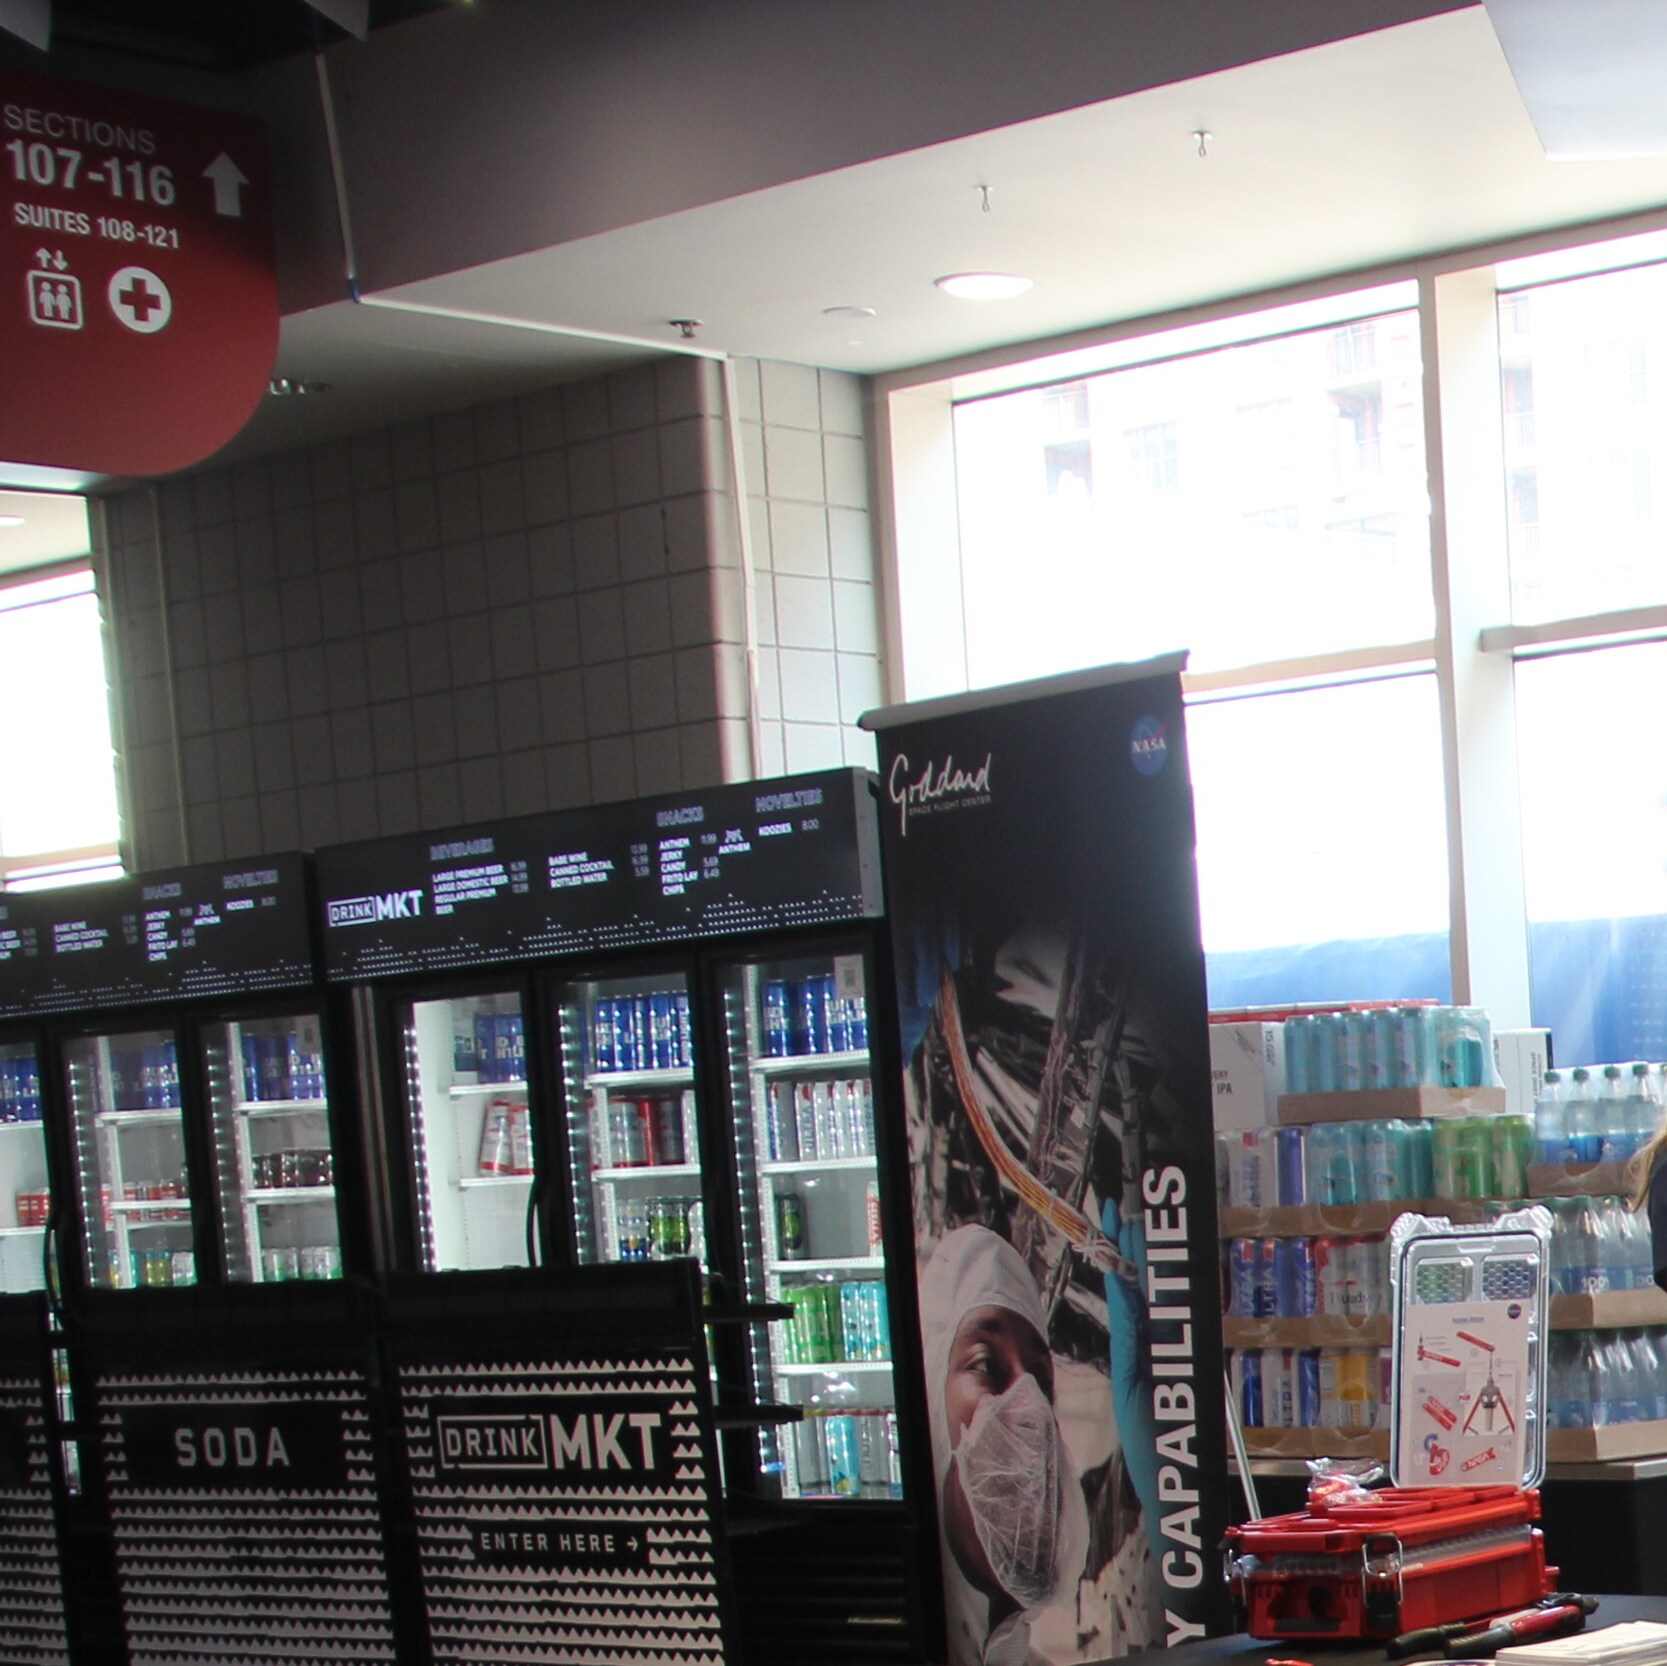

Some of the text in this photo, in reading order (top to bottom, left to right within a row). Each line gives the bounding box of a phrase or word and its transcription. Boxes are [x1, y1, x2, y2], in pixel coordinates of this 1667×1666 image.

[3, 104, 156, 154] SECTIONS
[6, 139, 175, 206] 107-116
[14, 202, 179, 249] SUITES 108-121
[1131, 737, 1166, 753] NASA
[890, 753, 991, 836] Goddard
[908, 796, 992, 816] SPACE FLIGHT CENTER
[758, 822, 793, 837] KOOZIES
[718, 842, 751, 854] ANTHEM
[549, 864, 579, 877] CANNED
[579, 860, 614, 873] COCKTAIL
[661, 861, 686, 872] CANDY
[550, 876, 583, 889] BOTTLED
[582, 872, 608, 884] WATER
[662, 872, 684, 884] FRITO
[684, 871, 698, 882] LAY
[663, 884, 685, 896] CHIPS
[331, 889, 423, 921] DRINK MKT
[1217, 1083, 1232, 1095] IPA
[1143, 1165, 1204, 1591] CAPABILITIES
[174, 1425, 290, 1468] SODA
[445, 1413, 662, 1469] DRINK MKT
[480, 1532, 615, 1552] ENTER HERE
